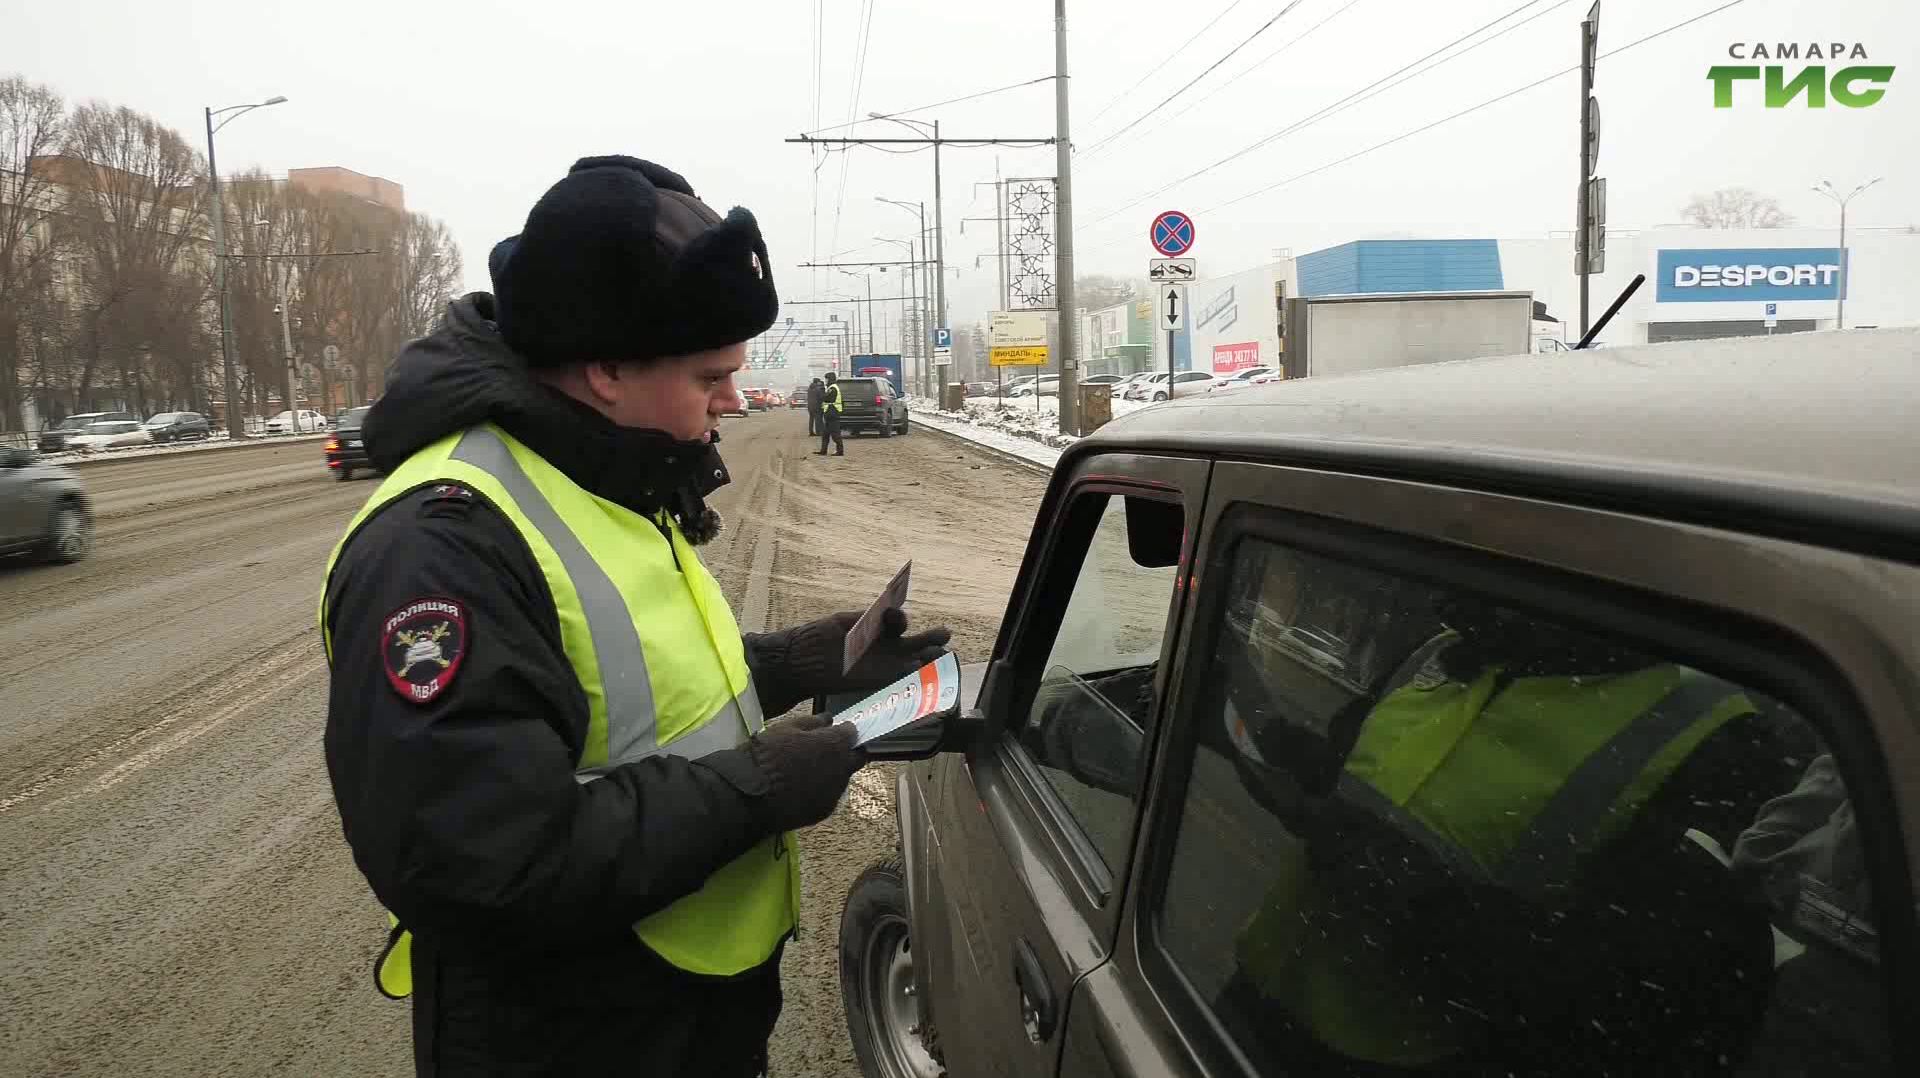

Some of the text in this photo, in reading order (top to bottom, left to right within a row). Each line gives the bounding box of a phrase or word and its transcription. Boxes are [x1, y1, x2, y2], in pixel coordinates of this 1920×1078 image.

[1674, 264, 1840, 287] DESPORT
[386, 602, 459, 632] ПОЛИЦИЯ
[410, 678, 440, 699] МВД
